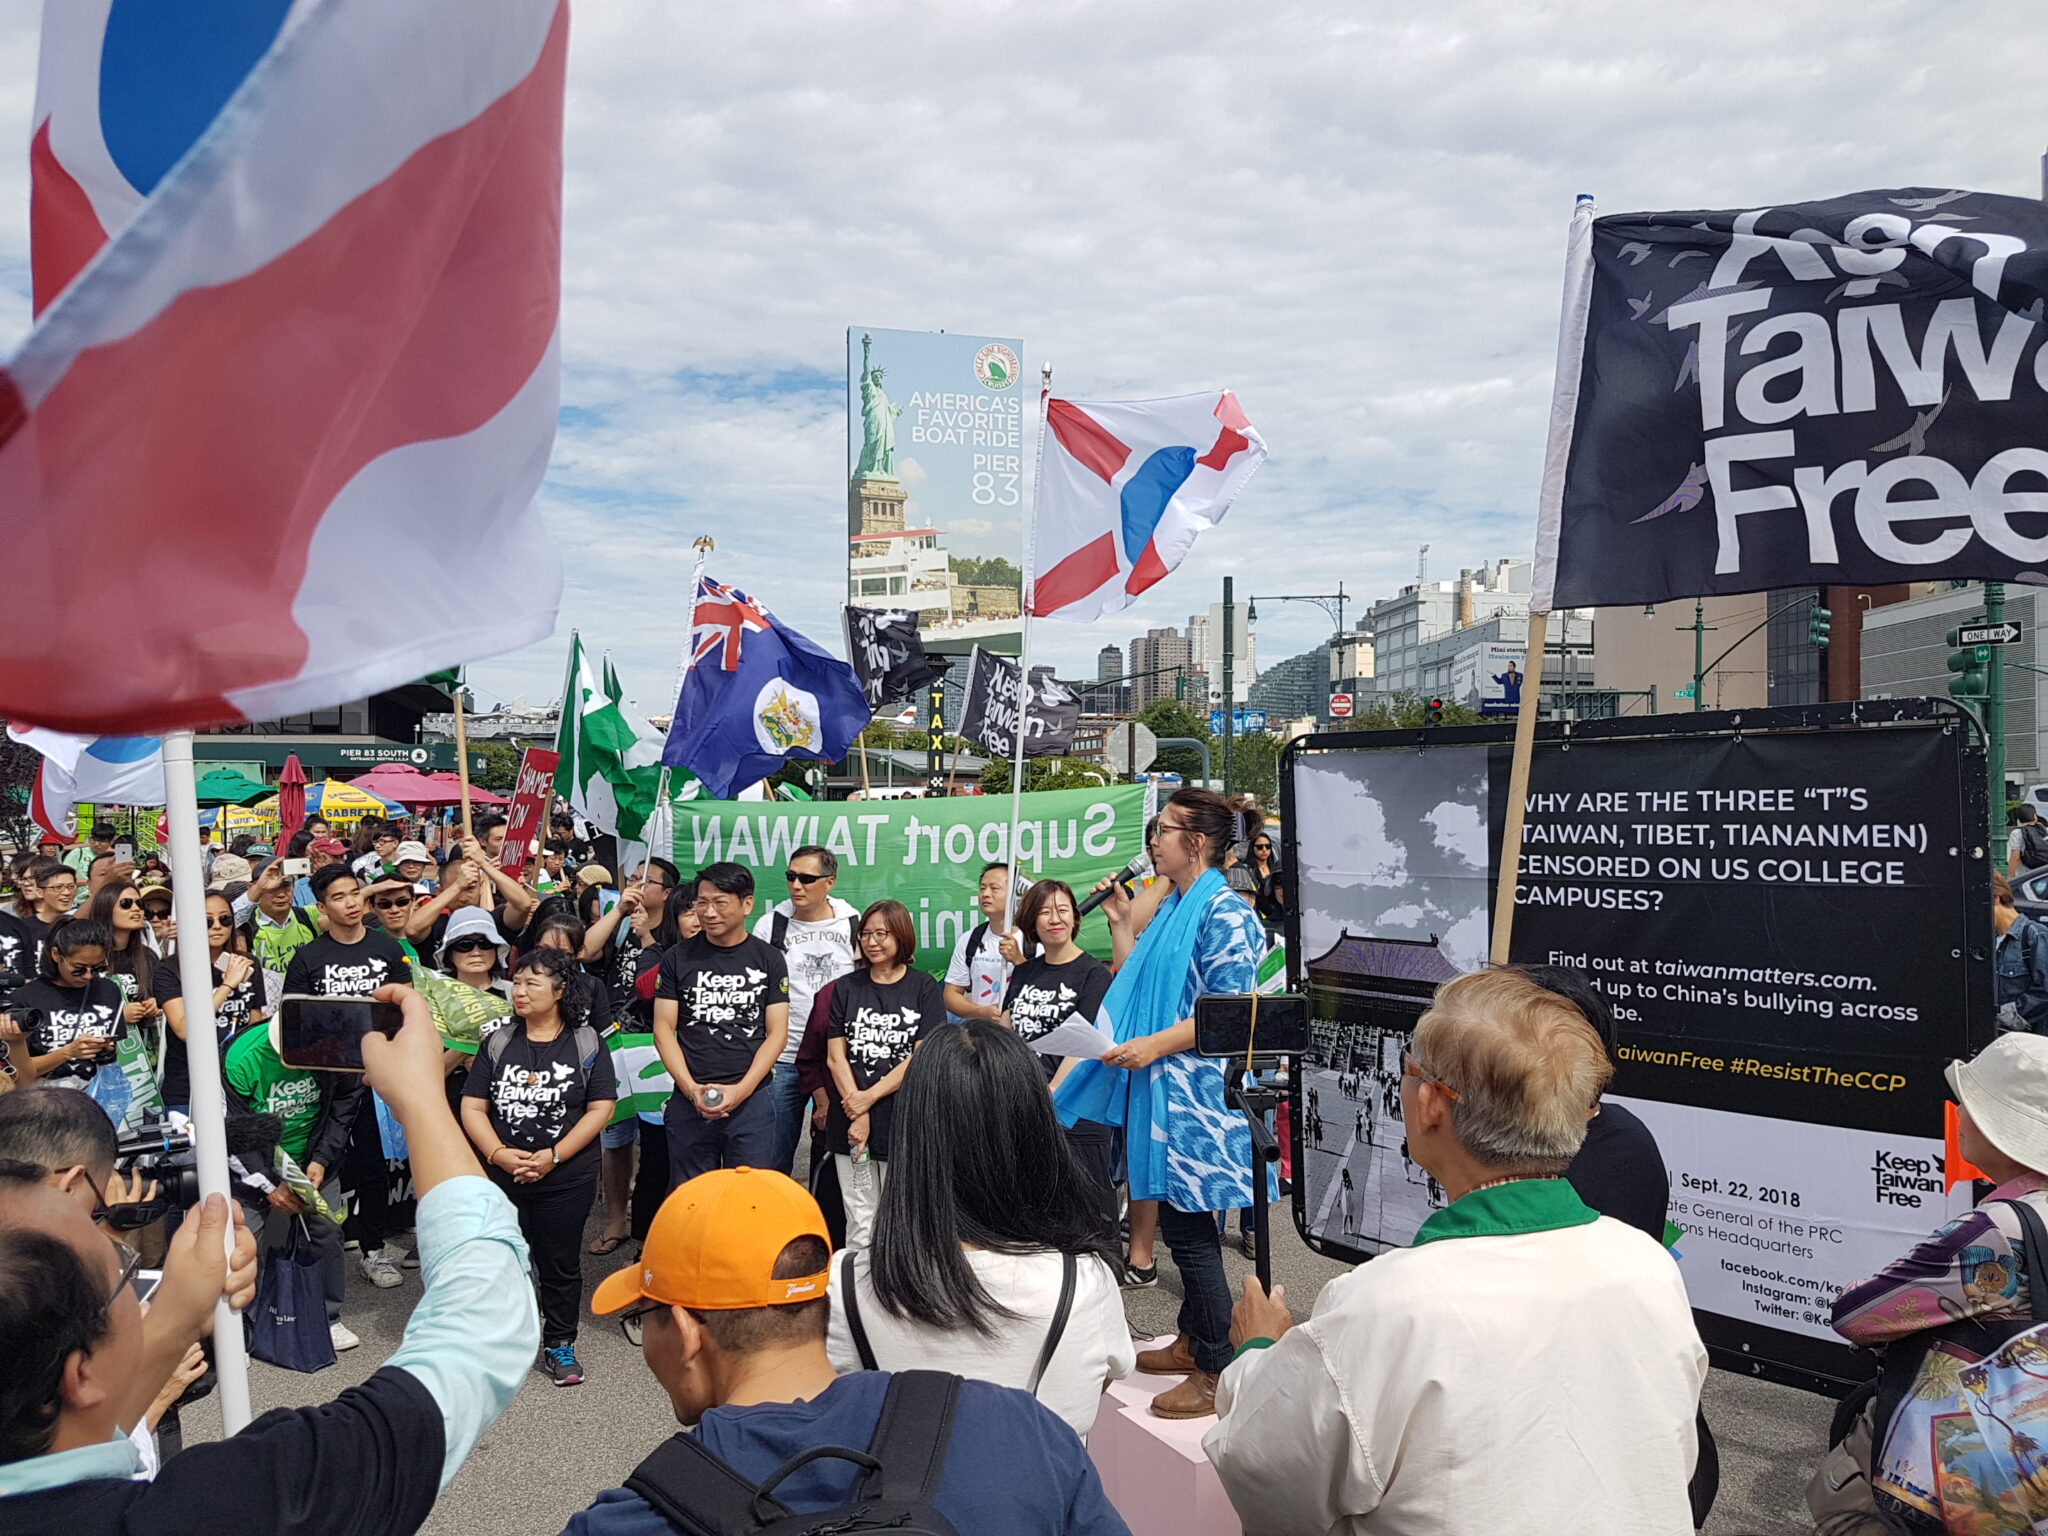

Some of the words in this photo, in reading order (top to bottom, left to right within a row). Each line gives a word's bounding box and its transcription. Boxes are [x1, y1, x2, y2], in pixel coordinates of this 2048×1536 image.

[909, 391, 1019, 413] AMERICA'S
[918, 409, 1019, 430] FAVORITE
[912, 426, 968, 445] BOAT
[973, 430, 1019, 448] RIDE
[973, 453, 1019, 472] PIER
[972, 471, 1019, 506] 83
[1703, 430, 2048, 574] Free
[1967, 631, 1985, 640] ONE
[1994, 629, 2012, 638] WAY
[989, 662, 1034, 710] Keep
[931, 692, 944, 771] TAXI
[979, 717, 1010, 757] Free
[378, 749, 409, 757] SOUTH
[1576, 792, 1628, 812] ARE
[1635, 791, 1688, 812] THE
[1696, 789, 1795, 812] THREE
[326, 808, 380, 817] SABRETT
[511, 804, 530, 829] ON
[1522, 824, 1624, 848] TAIWAN,
[1631, 824, 1716, 849] TIBET,
[1722, 823, 1928, 853] TIANANMEN)
[1516, 855, 1650, 878] CENSORED
[1658, 858, 1700, 879] ON
[1711, 859, 1750, 880] US
[1757, 859, 1905, 885] COLLEGE
[1513, 885, 1664, 911] CAMPUSES?
[785, 931, 816, 947] WEST
[819, 931, 849, 944] POIN
[325, 964, 369, 980] Keep
[697, 971, 746, 990] Keep
[1548, 951, 1587, 969] Find
[1592, 957, 1624, 972] out
[1629, 959, 1649, 974] at
[1655, 959, 1878, 991] taiwanmatters.com.
[322, 976, 381, 993] Taiwan
[692, 987, 756, 1004] Taiwan
[1019, 984, 1056, 1003] Keep
[1013, 998, 1059, 1018] Taiwan
[1607, 981, 1631, 999] up
[1637, 983, 1657, 999] to
[1744, 990, 1833, 1018] bullying
[1841, 1001, 1918, 1021] across
[50, 1010, 97, 1028] Keep
[693, 1004, 736, 1022] Free
[856, 1007, 900, 1029] Keep
[1012, 1014, 1042, 1033] Free
[1613, 1003, 1643, 1022] be.
[851, 1022, 908, 1043] Taiwan
[851, 1040, 891, 1058] Free
[1617, 1043, 1725, 1071] aiwanFree
[1730, 1057, 1906, 1092] #ResistTheCCP
[270, 1076, 316, 1098] Keep
[497, 1081, 560, 1102] Taiwan
[496, 1100, 539, 1118] Free
[1876, 1150, 1931, 1177] Keep
[1681, 1173, 1722, 1193] Sept.
[1728, 1182, 1753, 1200] 22,
[1759, 1187, 1801, 1207] 2018
[1871, 1167, 1944, 1193] Taiwan
[1876, 1185, 1922, 1208] Free
[1692, 1203, 1753, 1227] General
[1758, 1218, 1774, 1230] of
[1778, 1220, 1804, 1236] the
[1809, 1225, 1843, 1244] PRC
[1671, 1218, 1704, 1236] tions
[1708, 1225, 1813, 1259] Headquarters
[1721, 1259, 1843, 1294] facebook.com/ke
[1742, 1280, 1811, 1305] Instagram:
[1815, 1296, 1836, 1310] @k
[1755, 1300, 1799, 1320] Twitter:
[1803, 1311, 1832, 1327] @Ke
